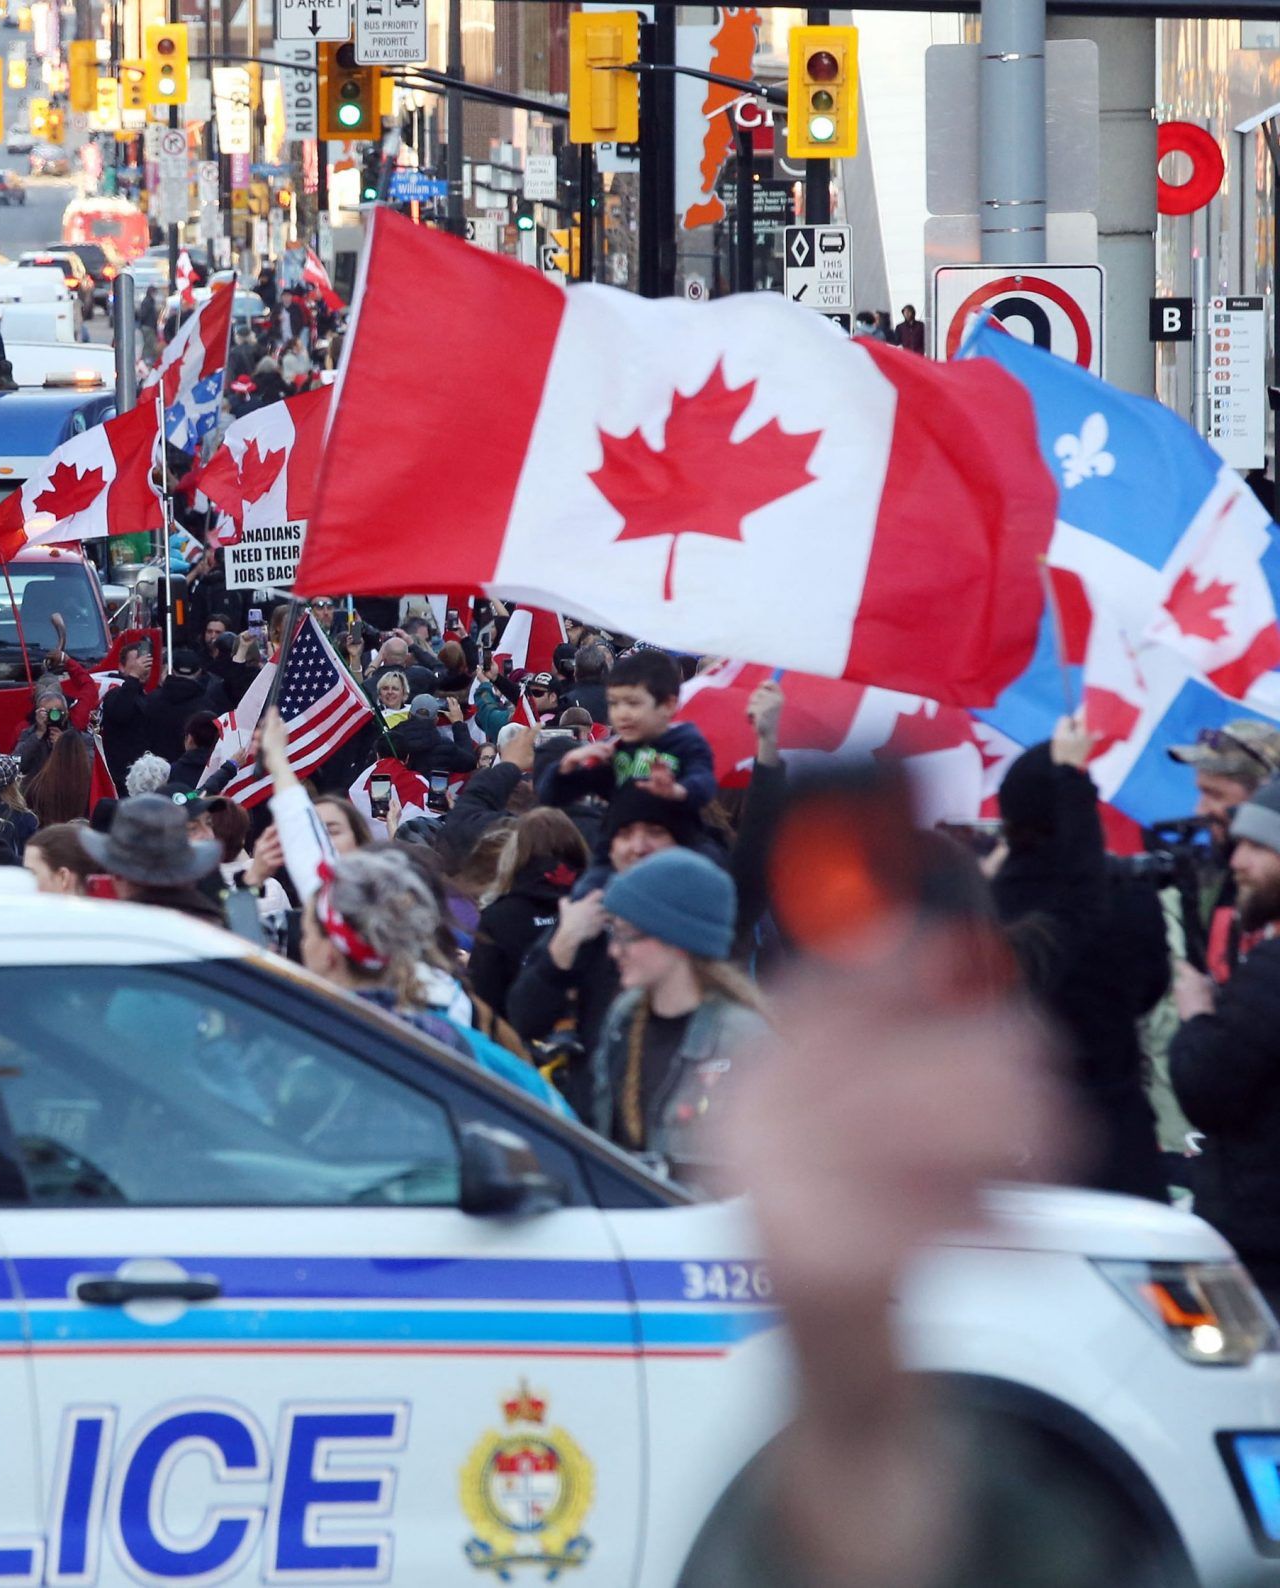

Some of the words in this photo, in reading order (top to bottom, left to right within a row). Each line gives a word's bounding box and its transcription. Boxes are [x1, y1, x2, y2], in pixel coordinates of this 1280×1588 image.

[284, 0, 342, 8] DARRT
[364, 21, 379, 30] BUS
[382, 20, 418, 30] PRIORITY
[372, 36, 408, 46] PRIORITÉ
[364, 50, 380, 58] AUX
[383, 49, 420, 58] AUTOBUS
[398, 182, 430, 195] William
[822, 260, 843, 269] THIS
[819, 270, 845, 280] LANE
[817, 285, 847, 295] CETTE
[822, 295, 844, 305] VOIE
[1162, 307, 1182, 333] B
[240, 525, 301, 543] ANADIANS
[232, 547, 262, 563] NEED
[265, 545, 300, 561] THEIR
[234, 567, 264, 583] JOBS
[681, 1262, 773, 1299] 3426
